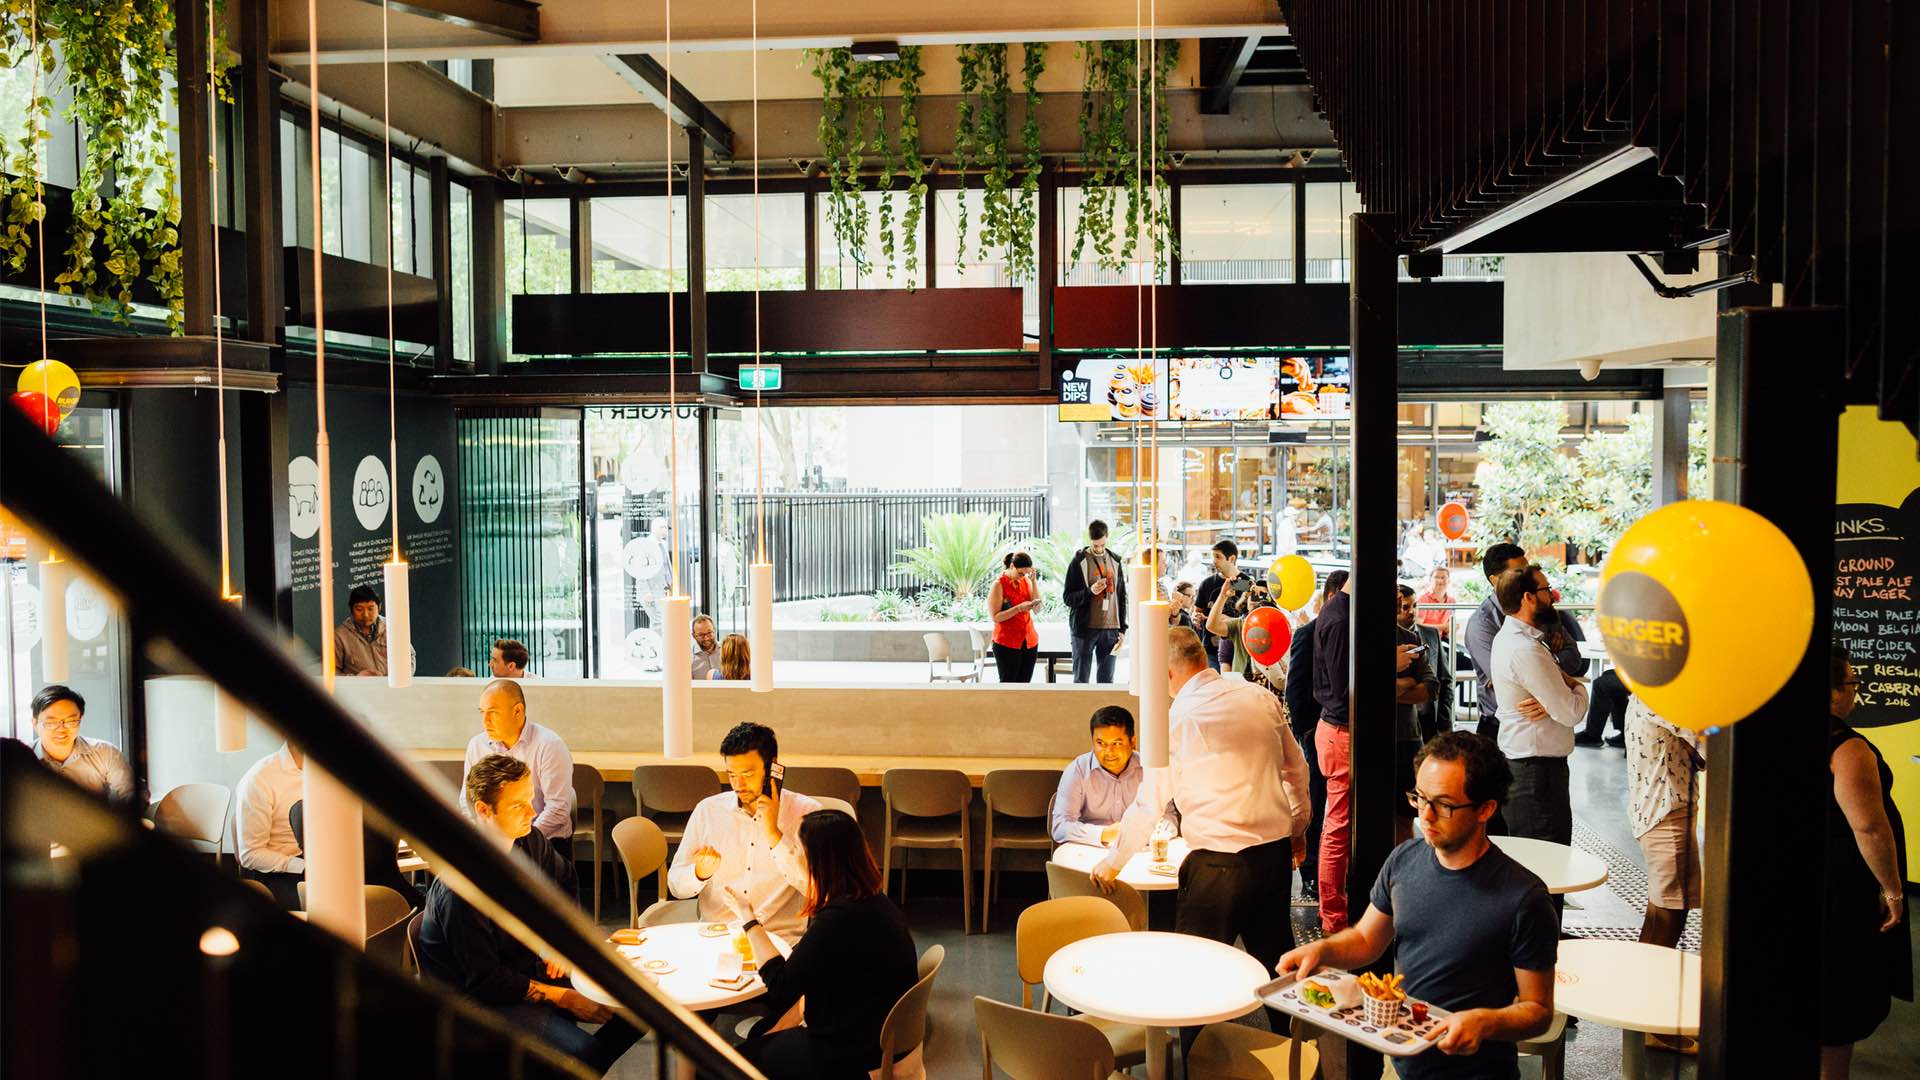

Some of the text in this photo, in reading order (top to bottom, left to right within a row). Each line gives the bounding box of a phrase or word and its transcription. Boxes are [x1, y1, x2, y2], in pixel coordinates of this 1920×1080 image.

[1063, 382, 1088, 391] NEW
[1063, 392, 1088, 401] DIPS
[1838, 557, 1894, 572] GROUND
[1836, 576, 1913, 587] ST PALE ALE
[1863, 588, 1911, 601] LAGER
[1832, 608, 1878, 619] NELSON
[1886, 609, 1914, 621] PALE
[1834, 621, 1869, 633] MOON
[1840, 638, 1875, 650] THIEF
[1876, 639, 1916, 653] CIDER
[1878, 653, 1907, 661] LADY
[1885, 698, 1910, 707] 2016
